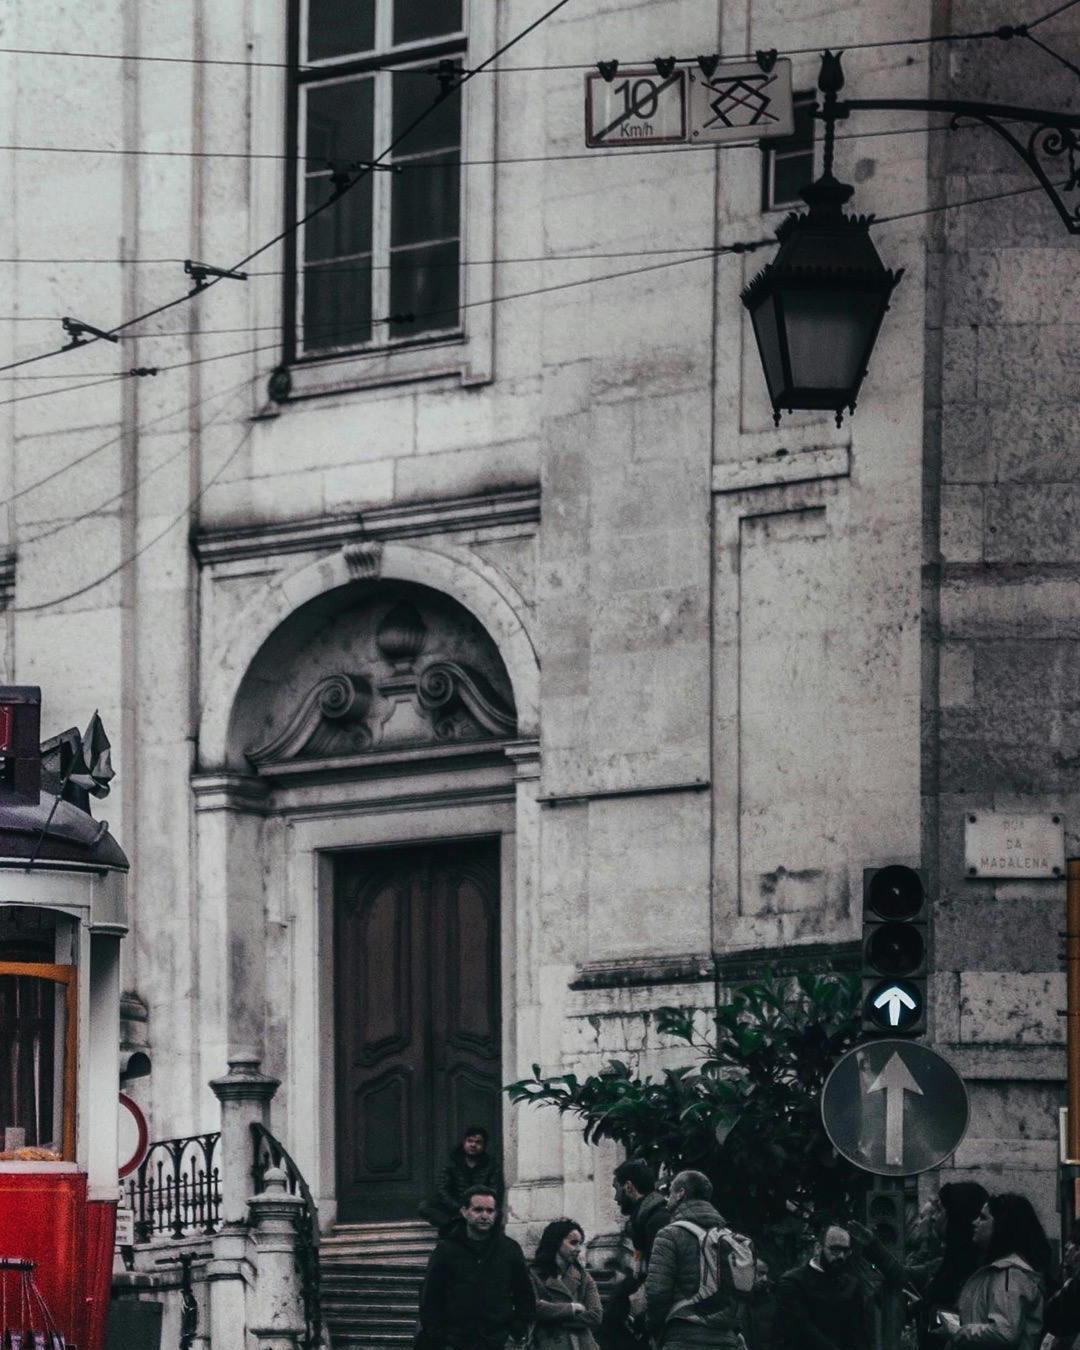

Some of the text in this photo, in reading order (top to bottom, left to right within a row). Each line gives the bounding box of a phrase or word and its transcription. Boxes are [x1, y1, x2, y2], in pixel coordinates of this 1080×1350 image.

[615, 79, 658, 119] 10
[621, 123, 653, 137] Km/h
[1006, 839, 1022, 850] DA
[980, 857, 1049, 869] MADALENA
